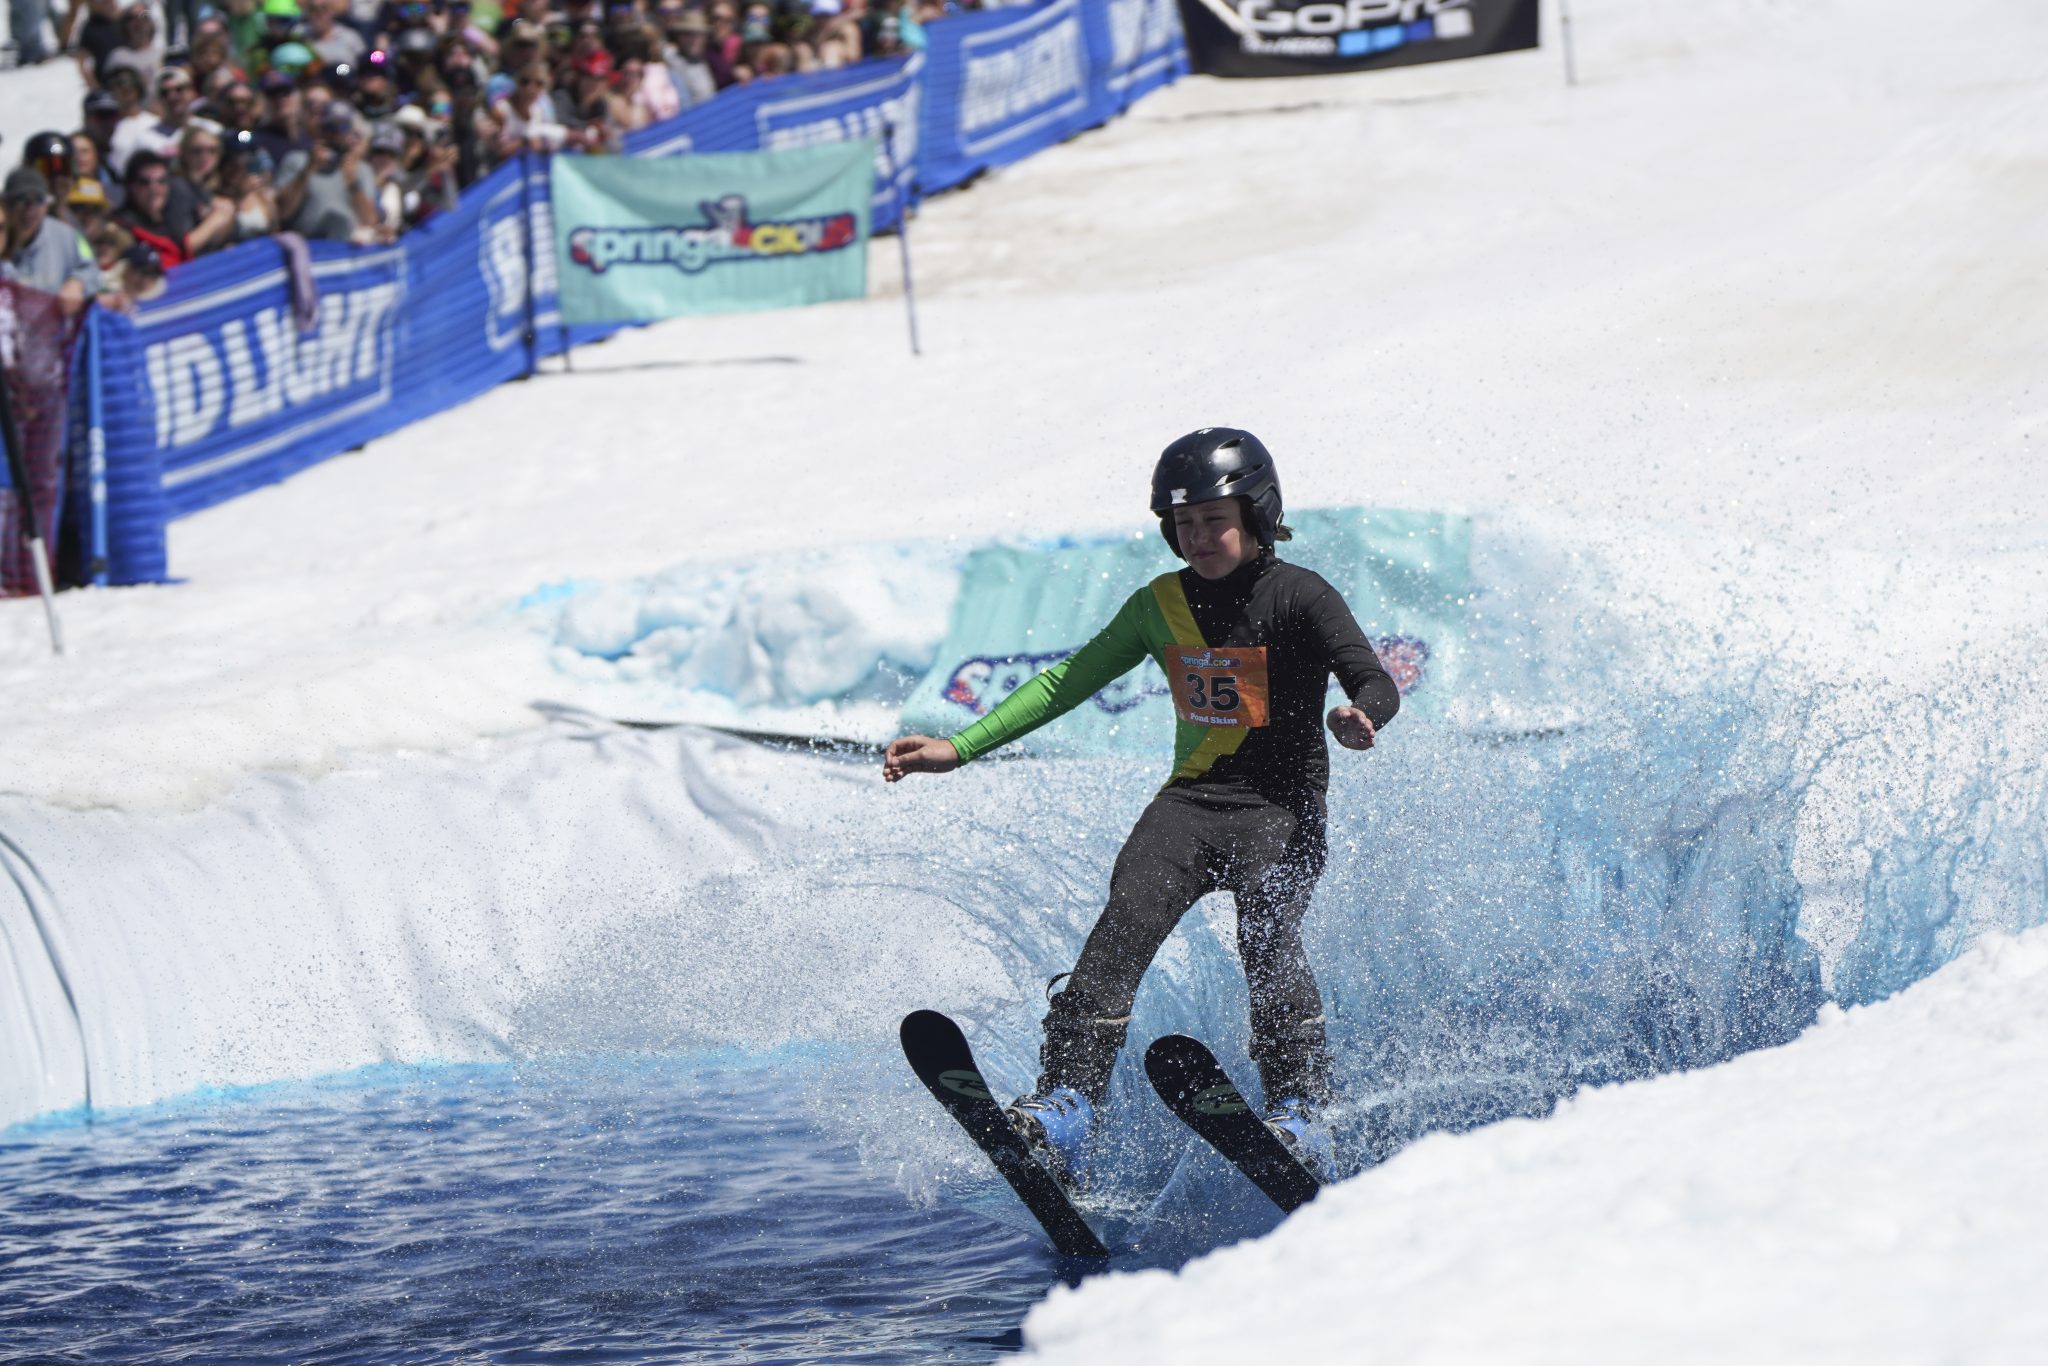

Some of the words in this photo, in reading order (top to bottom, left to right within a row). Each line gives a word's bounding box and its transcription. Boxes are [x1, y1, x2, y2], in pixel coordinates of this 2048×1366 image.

[1185, 672, 1240, 712] 35
[1190, 712, 1209, 723] Pond
[1210, 716, 1237, 725] Skim
